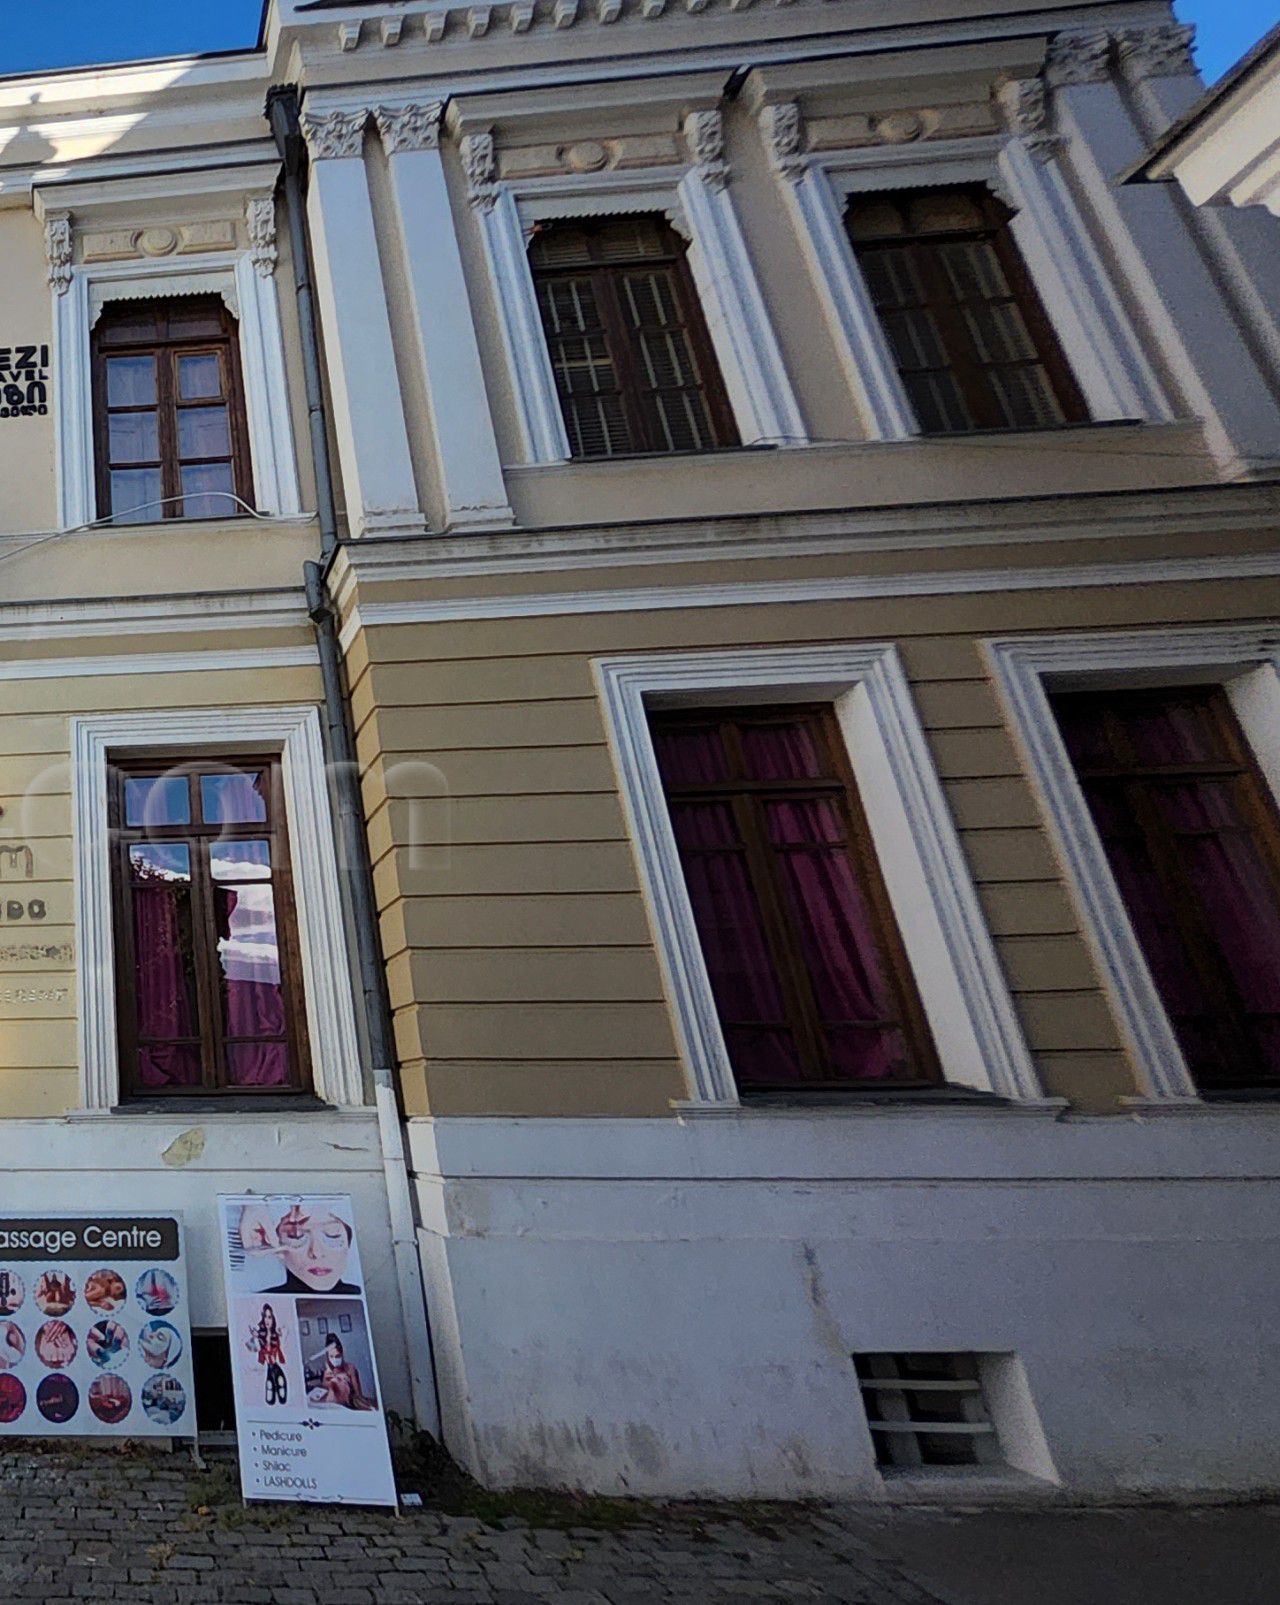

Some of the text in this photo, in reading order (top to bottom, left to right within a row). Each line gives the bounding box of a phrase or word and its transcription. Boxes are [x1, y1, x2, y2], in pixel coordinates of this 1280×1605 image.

[83, 1225, 162, 1249] Centre
[259, 1429, 303, 1442] Pedicure
[261, 1444, 308, 1457] Manicure
[264, 1475, 318, 1490] LASHDOLLS
